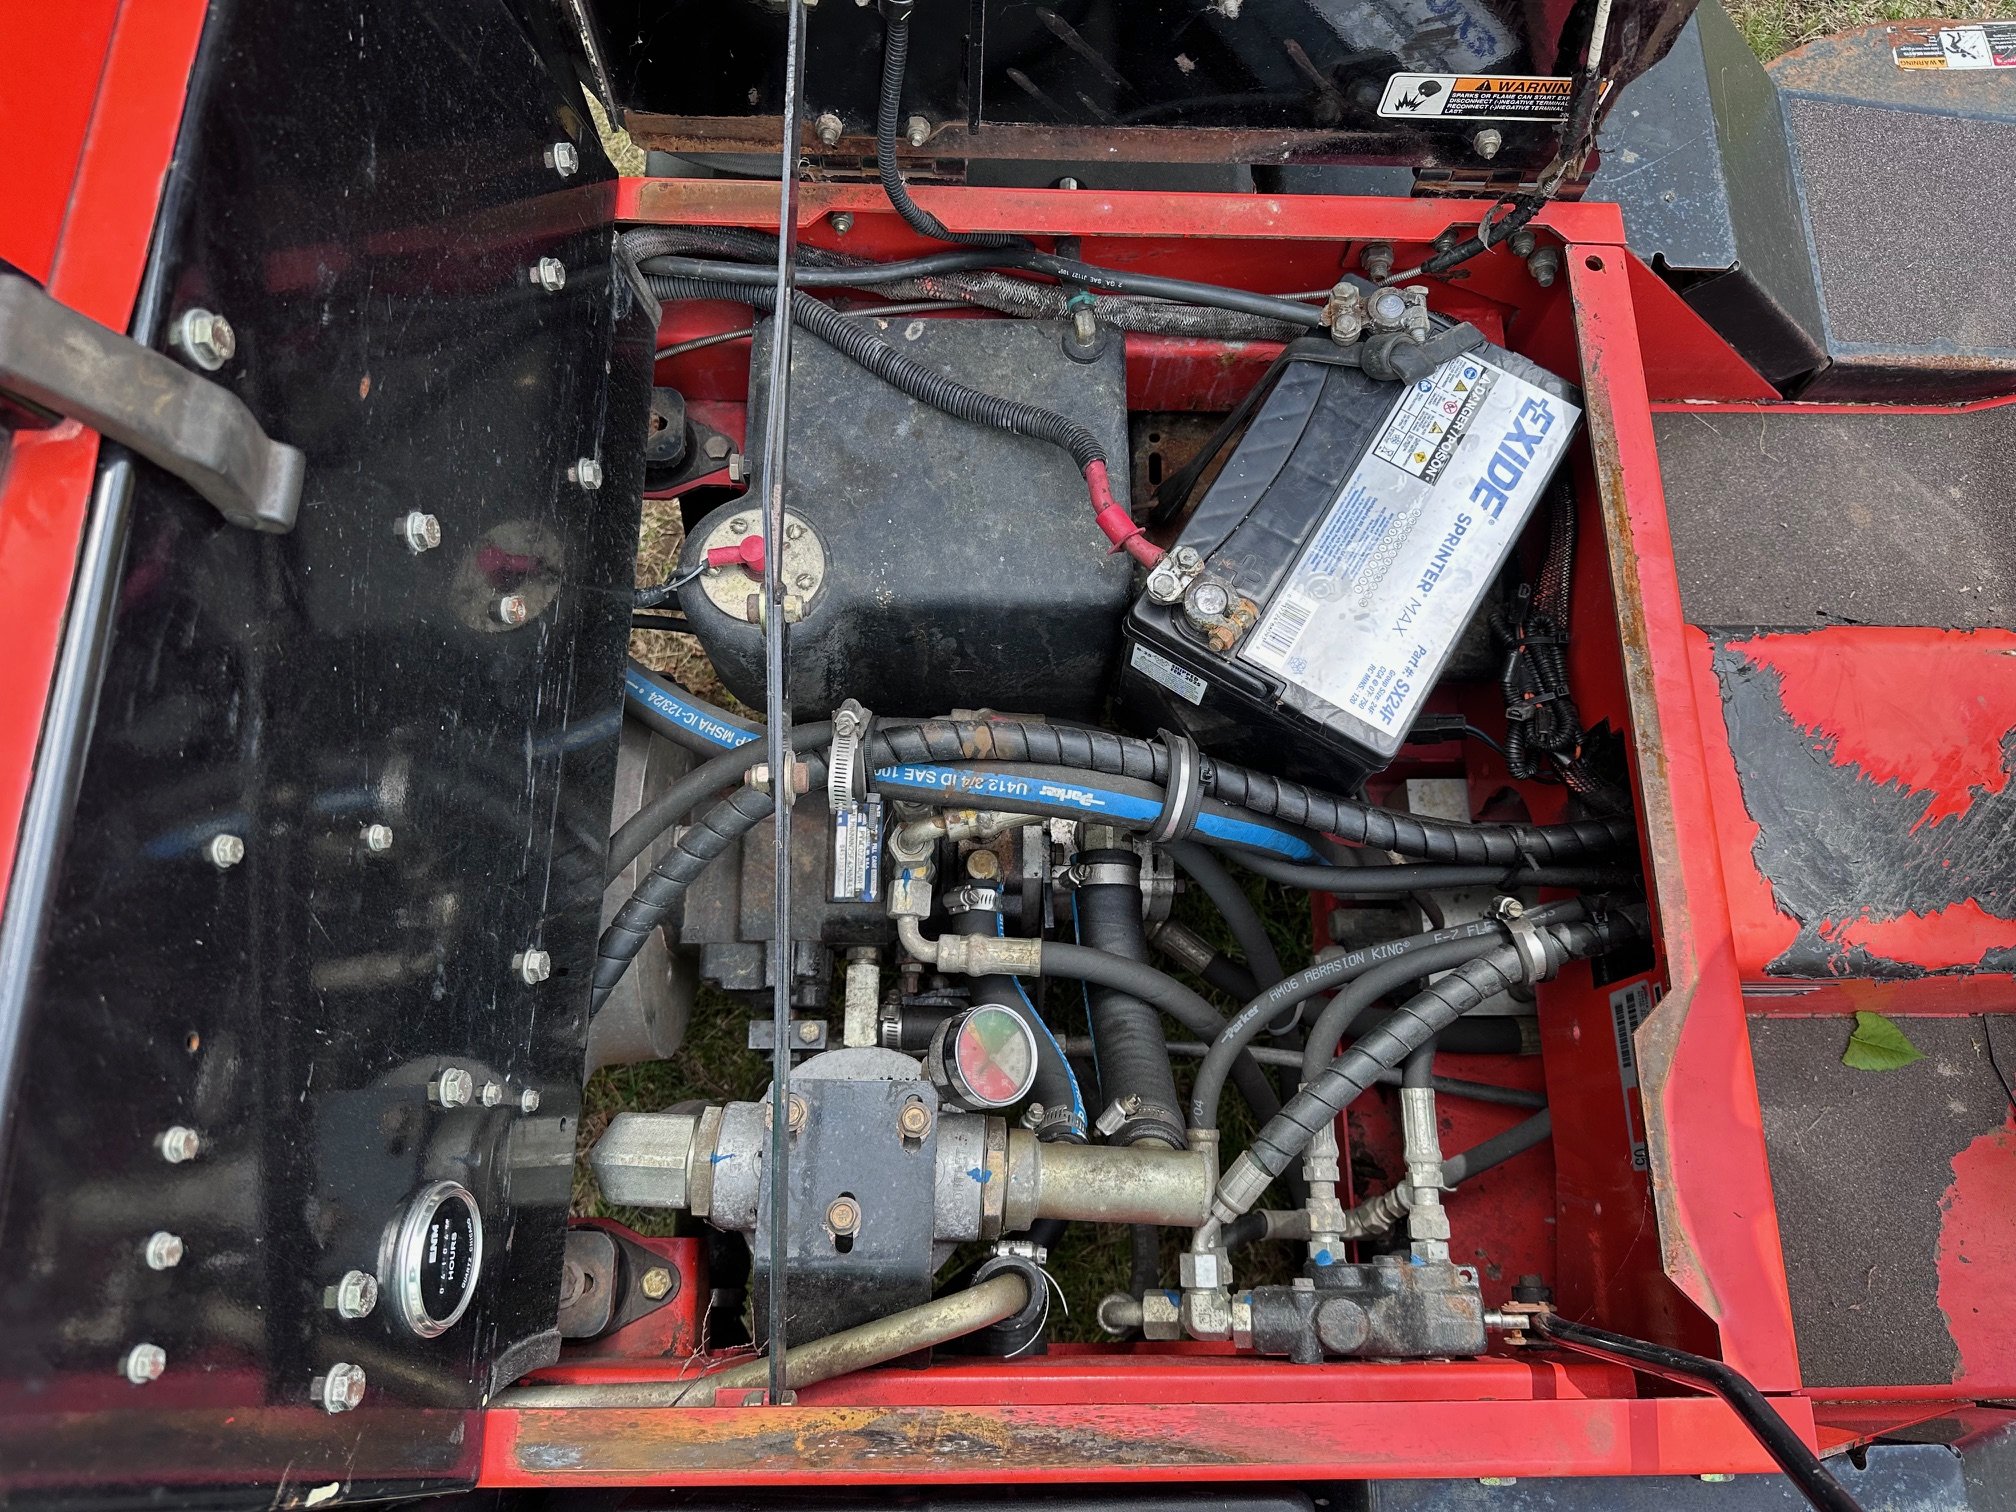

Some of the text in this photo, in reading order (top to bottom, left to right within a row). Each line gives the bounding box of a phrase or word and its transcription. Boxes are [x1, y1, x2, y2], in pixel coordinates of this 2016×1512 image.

[1499, 81, 1571, 93] WARNIN
[1071, 271, 1087, 280] J1127
[1392, 597, 1421, 636] MAX
[1408, 644, 1426, 667] Part
[1367, 663, 1376, 674] RC
[1375, 665, 1386, 679] CCA
[1184, 676, 1201, 687] 2025
[1367, 669, 1395, 715] Group Size: 24F
[646, 689, 700, 726] IC-123/24
[1349, 692, 1359, 704] 120
[1358, 696, 1368, 709] 750
[1379, 678, 1409, 724] SX24F
[696, 716, 735, 745] MSHA
[903, 766, 937, 783] SAE
[939, 771, 957, 786] ID
[986, 777, 1028, 794] U412
[1037, 783, 1094, 806] Parker
[1222, 1004, 1259, 1043] Parker
[1268, 978, 1300, 1002] AM06
[1304, 954, 1366, 984] ABRASION
[428, 1224, 440, 1263] ENM
[461, 1217, 474, 1288] QUARTZ CHICAGO
[447, 1231, 458, 1280] HOURS
